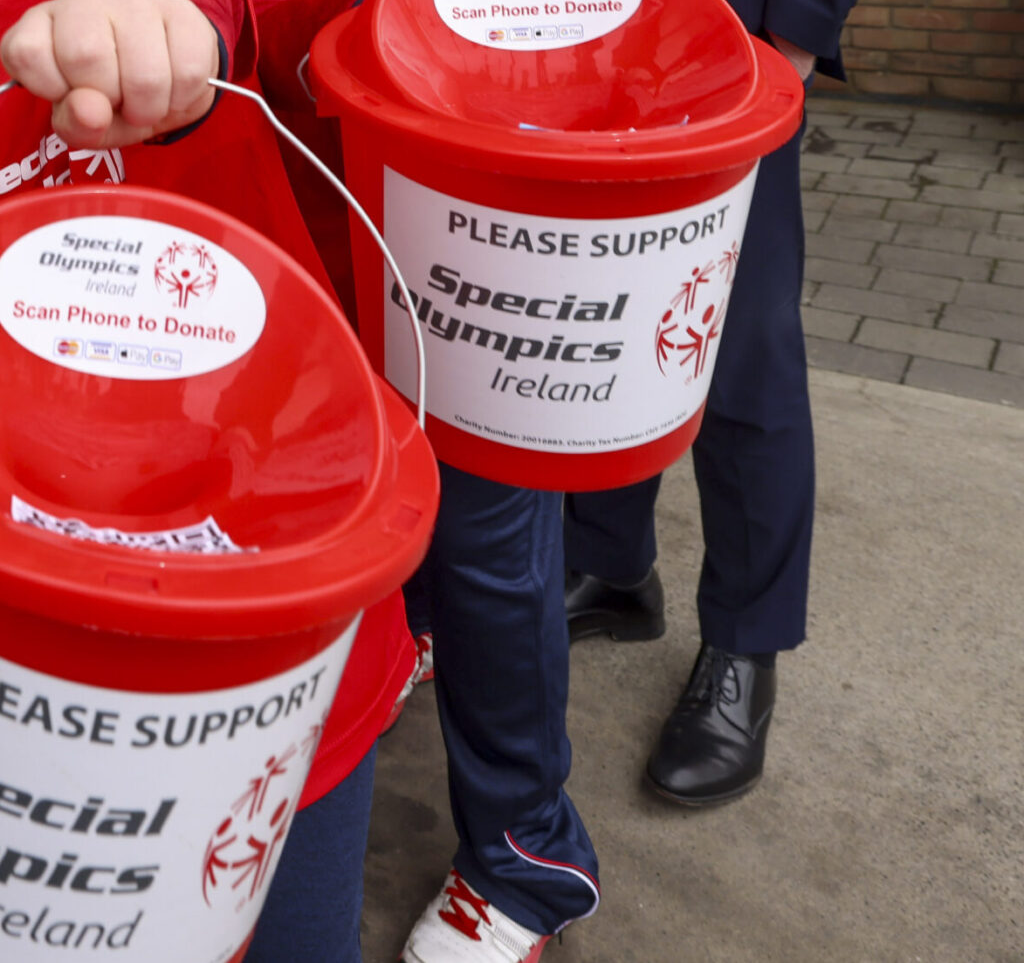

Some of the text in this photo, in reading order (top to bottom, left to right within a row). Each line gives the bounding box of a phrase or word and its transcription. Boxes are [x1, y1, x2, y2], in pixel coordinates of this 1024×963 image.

[452, 0, 623, 20] Scan Phone to Donate
[62, 232, 143, 256] Special
[448, 204, 731, 258] PLEASE SUPPORT
[39, 251, 140, 277] Olympics
[85, 278, 138, 298] Ireland
[427, 263, 630, 322] Special
[12, 300, 237, 345] Scan Phone to Donate
[390, 279, 624, 363] Olympics
[489, 366, 618, 403] Ireland
[454, 414, 483, 431] Charity
[131, 665, 328, 749] SUPPORT
